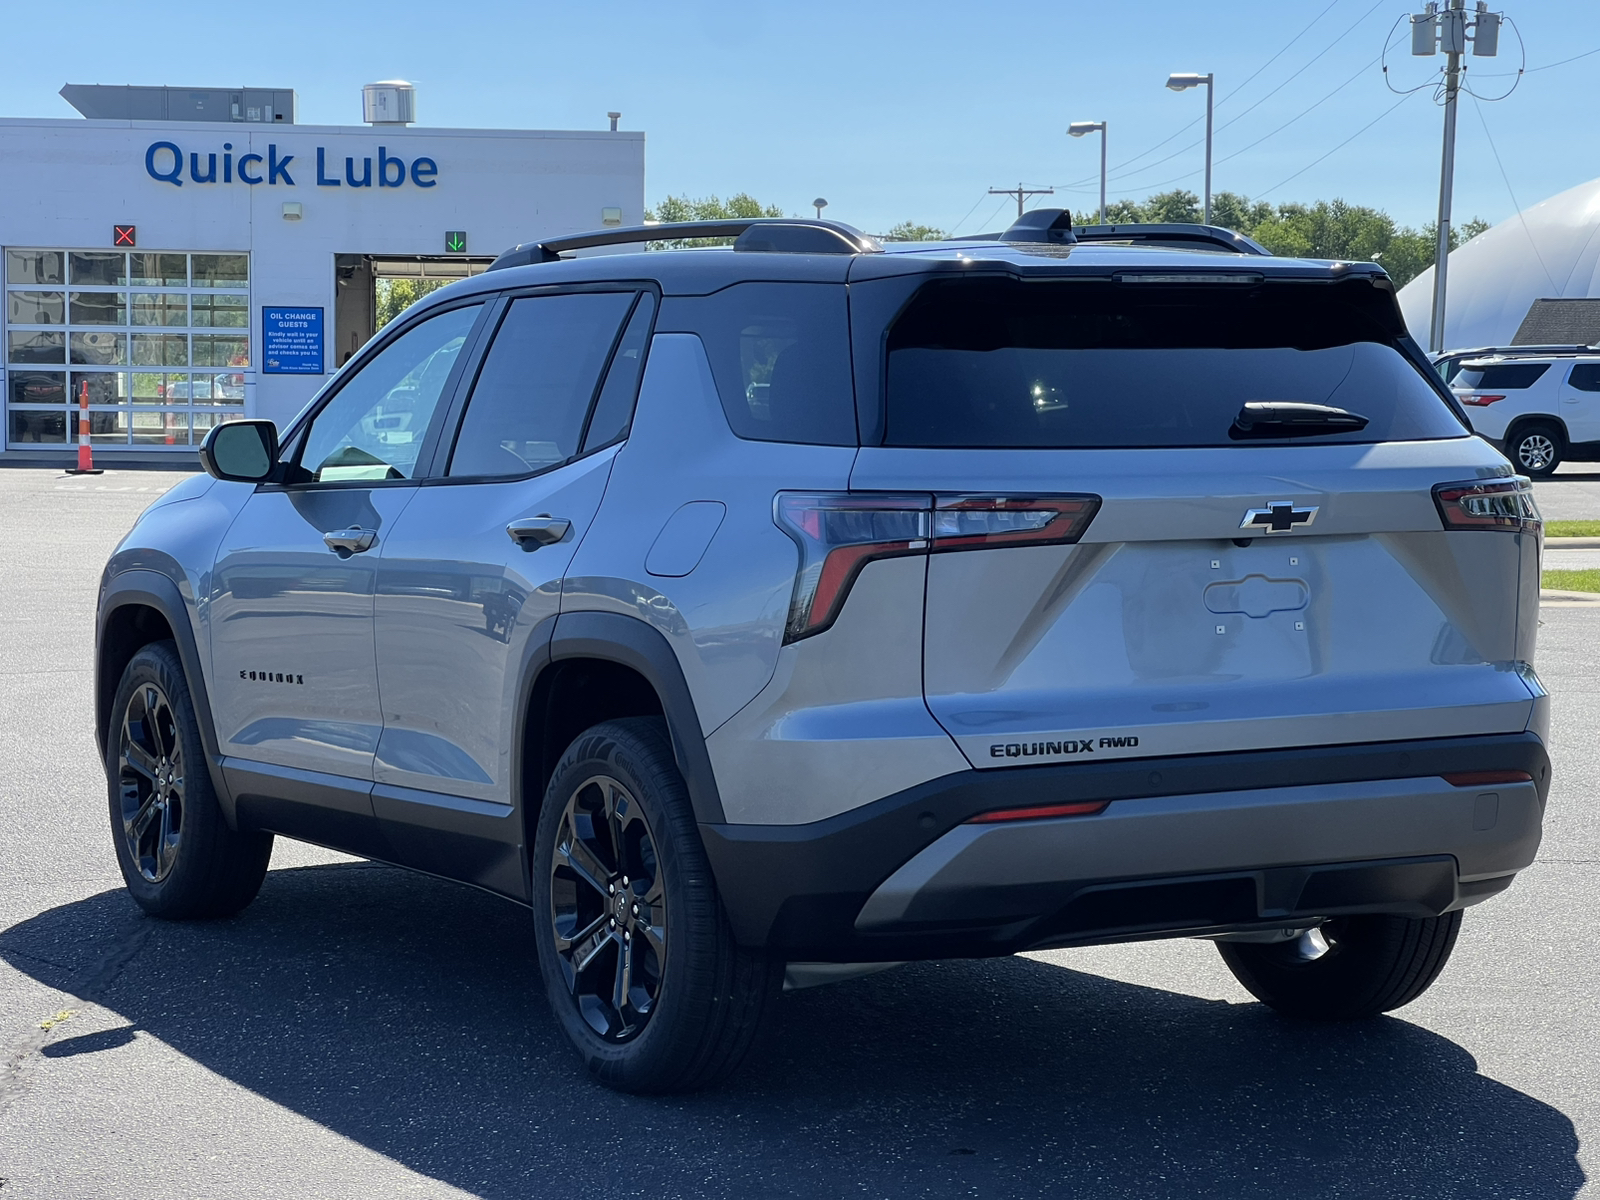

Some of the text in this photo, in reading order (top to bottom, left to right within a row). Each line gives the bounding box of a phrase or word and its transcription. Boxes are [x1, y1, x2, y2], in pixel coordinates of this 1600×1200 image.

[145, 141, 438, 188] Quick Lube
[239, 669, 303, 685] EQUINOX
[990, 736, 1139, 758] EQUINOX AWD
[614, 751, 653, 803] Continental
